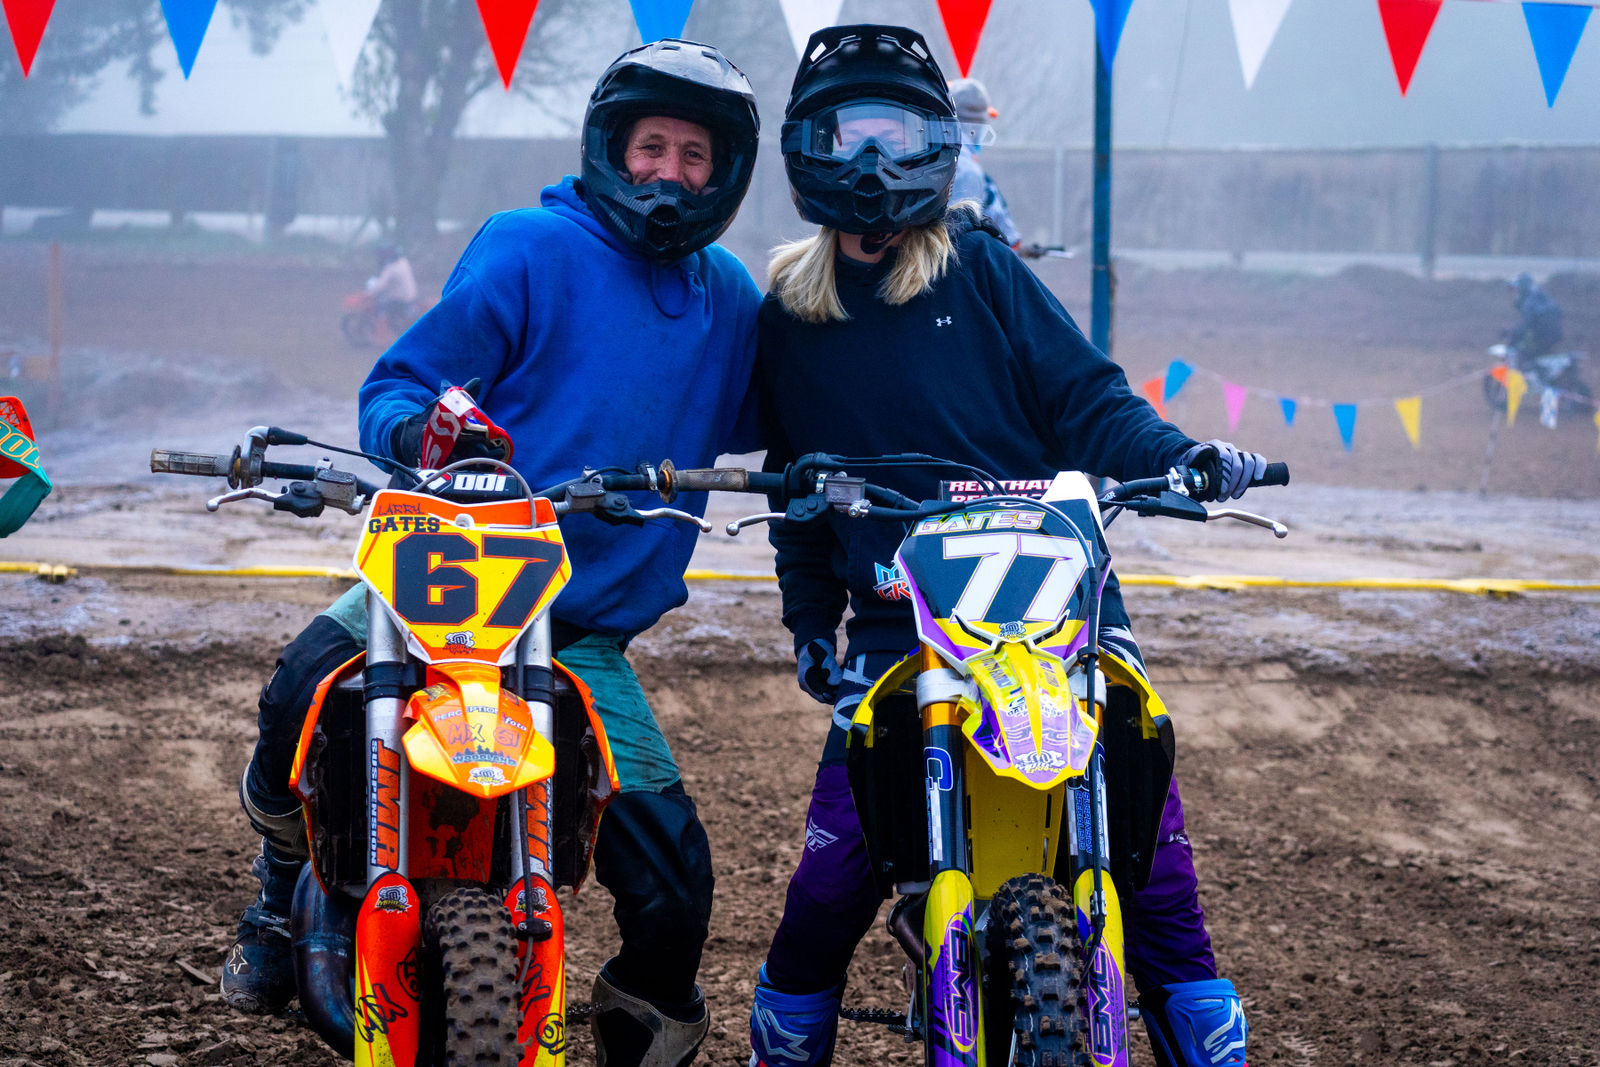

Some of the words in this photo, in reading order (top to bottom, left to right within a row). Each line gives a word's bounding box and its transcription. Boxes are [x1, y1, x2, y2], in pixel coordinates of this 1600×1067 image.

[368, 516, 440, 534] GATES
[912, 510, 1046, 537] GATES
[392, 531, 565, 629] 67
[942, 533, 1092, 624] 77
[449, 723, 486, 745] MX
[452, 754, 518, 767] WOODLAND
[377, 739, 400, 871] JMR
[526, 780, 549, 871] JM
[1083, 791, 1093, 854] SUSPENSION
